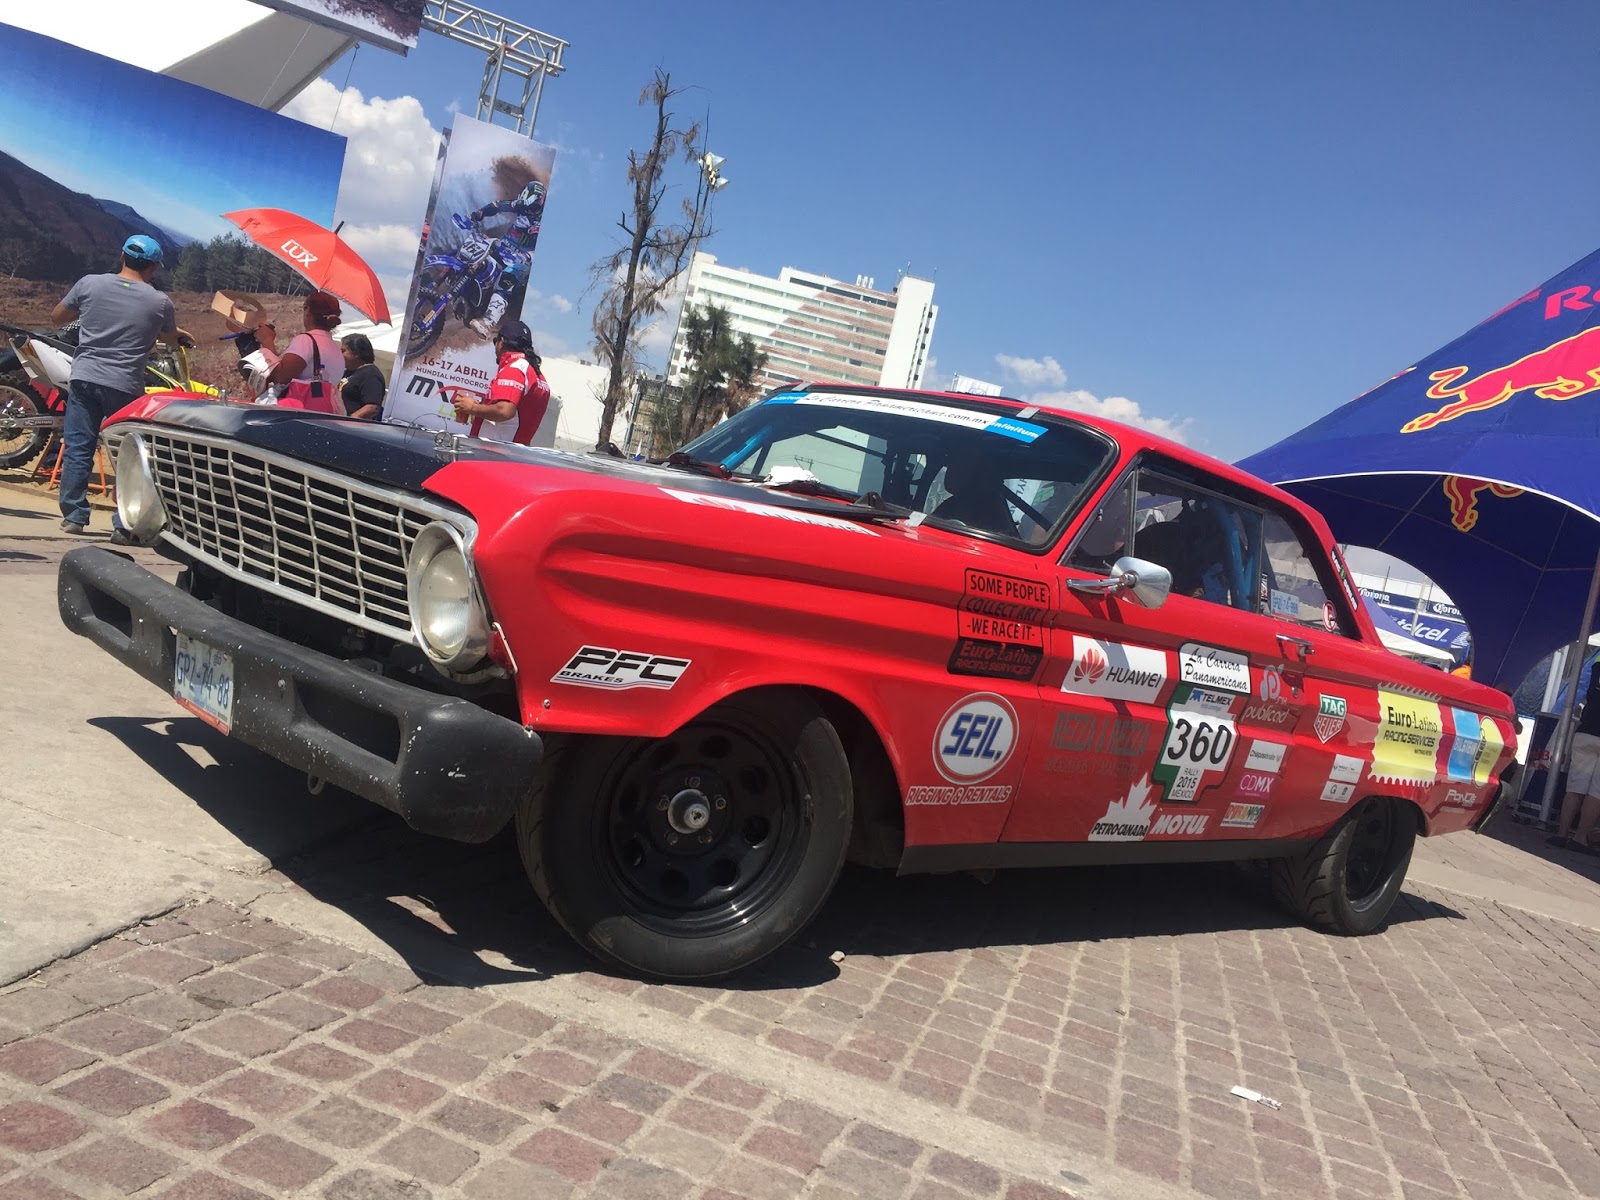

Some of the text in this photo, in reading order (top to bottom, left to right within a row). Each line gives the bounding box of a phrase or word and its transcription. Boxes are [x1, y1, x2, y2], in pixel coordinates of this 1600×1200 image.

[281, 239, 318, 268] LUX
[422, 355, 489, 380] 16-17 ABRIL
[416, 367, 449, 379] MUNDIAL
[449, 375, 492, 390] MOTOCROS
[990, 422, 1040, 438] infinitum
[970, 575, 1046, 603] SOME PEOPLE
[1358, 588, 1390, 601] Corona
[966, 598, 1042, 621] COLLECT ART
[991, 621, 1020, 639] RACE
[565, 647, 690, 682] PFC
[1188, 647, 1241, 673] La Carrera
[559, 670, 625, 684] BRAKES
[1106, 666, 1162, 688] HUAWEI
[1184, 662, 1249, 690] Panamericana
[1203, 693, 1233, 706] TELMEX
[1322, 698, 1345, 716] TAG
[1316, 716, 1342, 739] HEUER
[1167, 718, 1233, 765] 360
[1384, 729, 1436, 748] RACING SERVICES
[1183, 767, 1200, 776] RALLY
[1176, 776, 1198, 789] 2015
[1240, 774, 1275, 793] CDMX
[905, 785, 1013, 805] RIGGING & RENTALS
[1150, 815, 1210, 835] MOTUL
